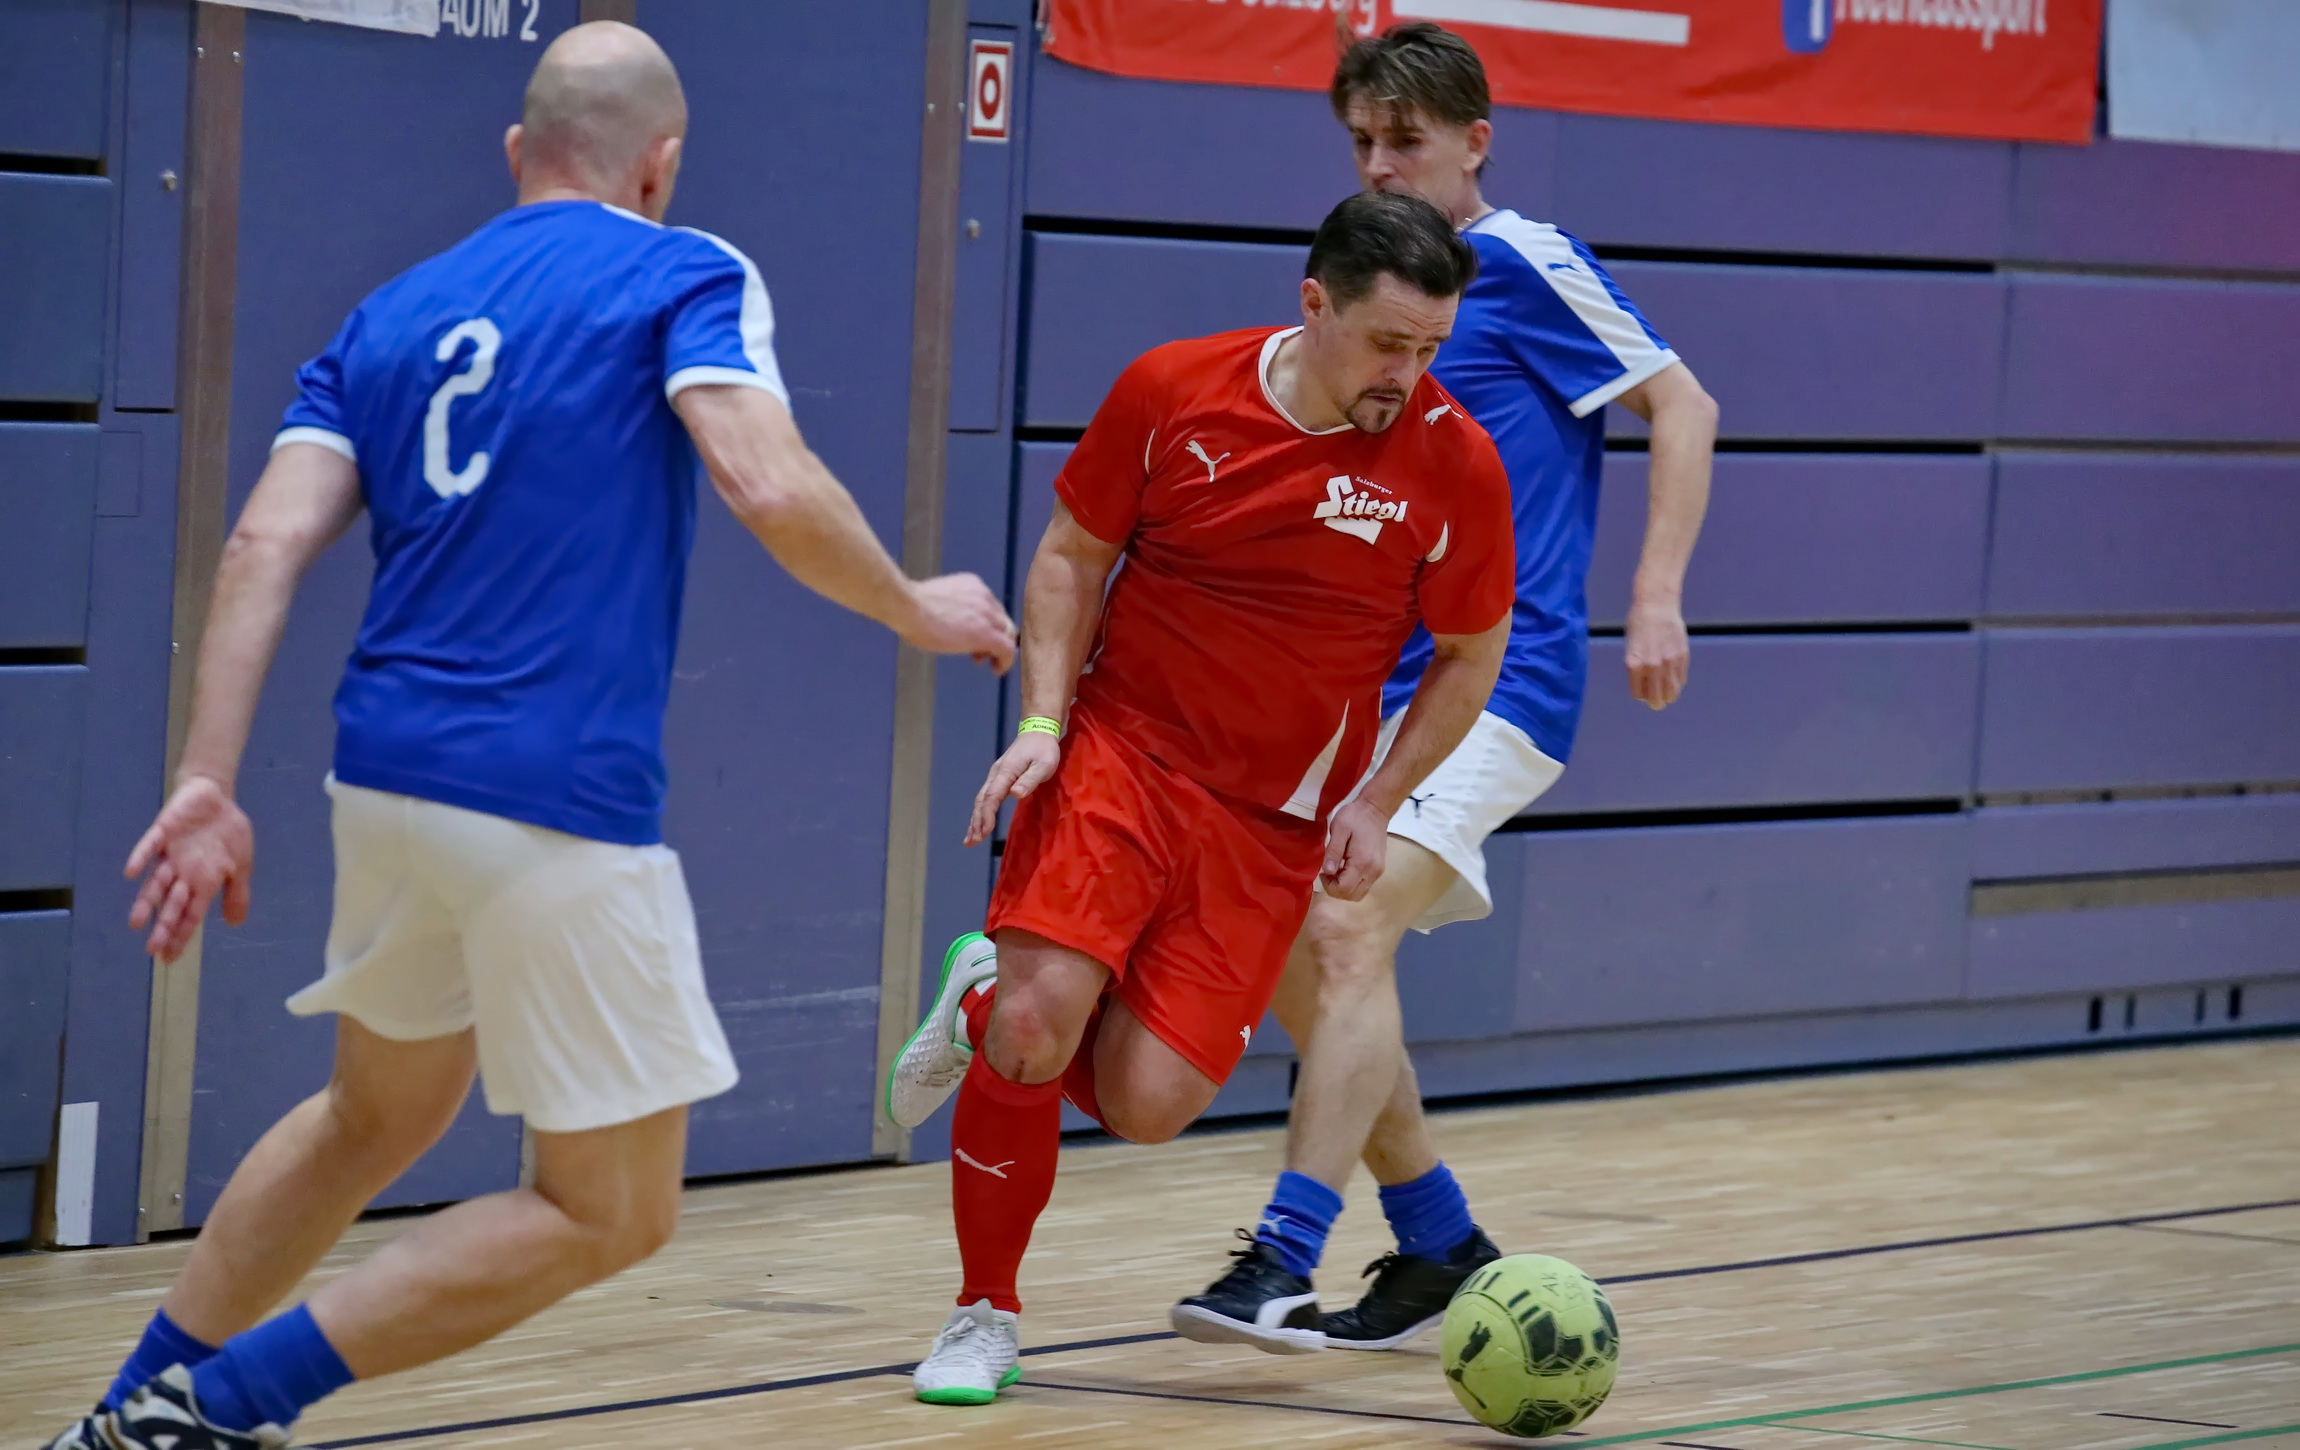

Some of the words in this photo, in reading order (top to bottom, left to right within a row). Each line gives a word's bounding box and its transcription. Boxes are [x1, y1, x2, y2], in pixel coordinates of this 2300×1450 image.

[441, 0, 509, 38] AUM
[520, 0, 540, 41] 2
[424, 317, 502, 499] 2
[1313, 475, 1408, 522] Stiegl
[1355, 476, 1393, 495] Salzburger
